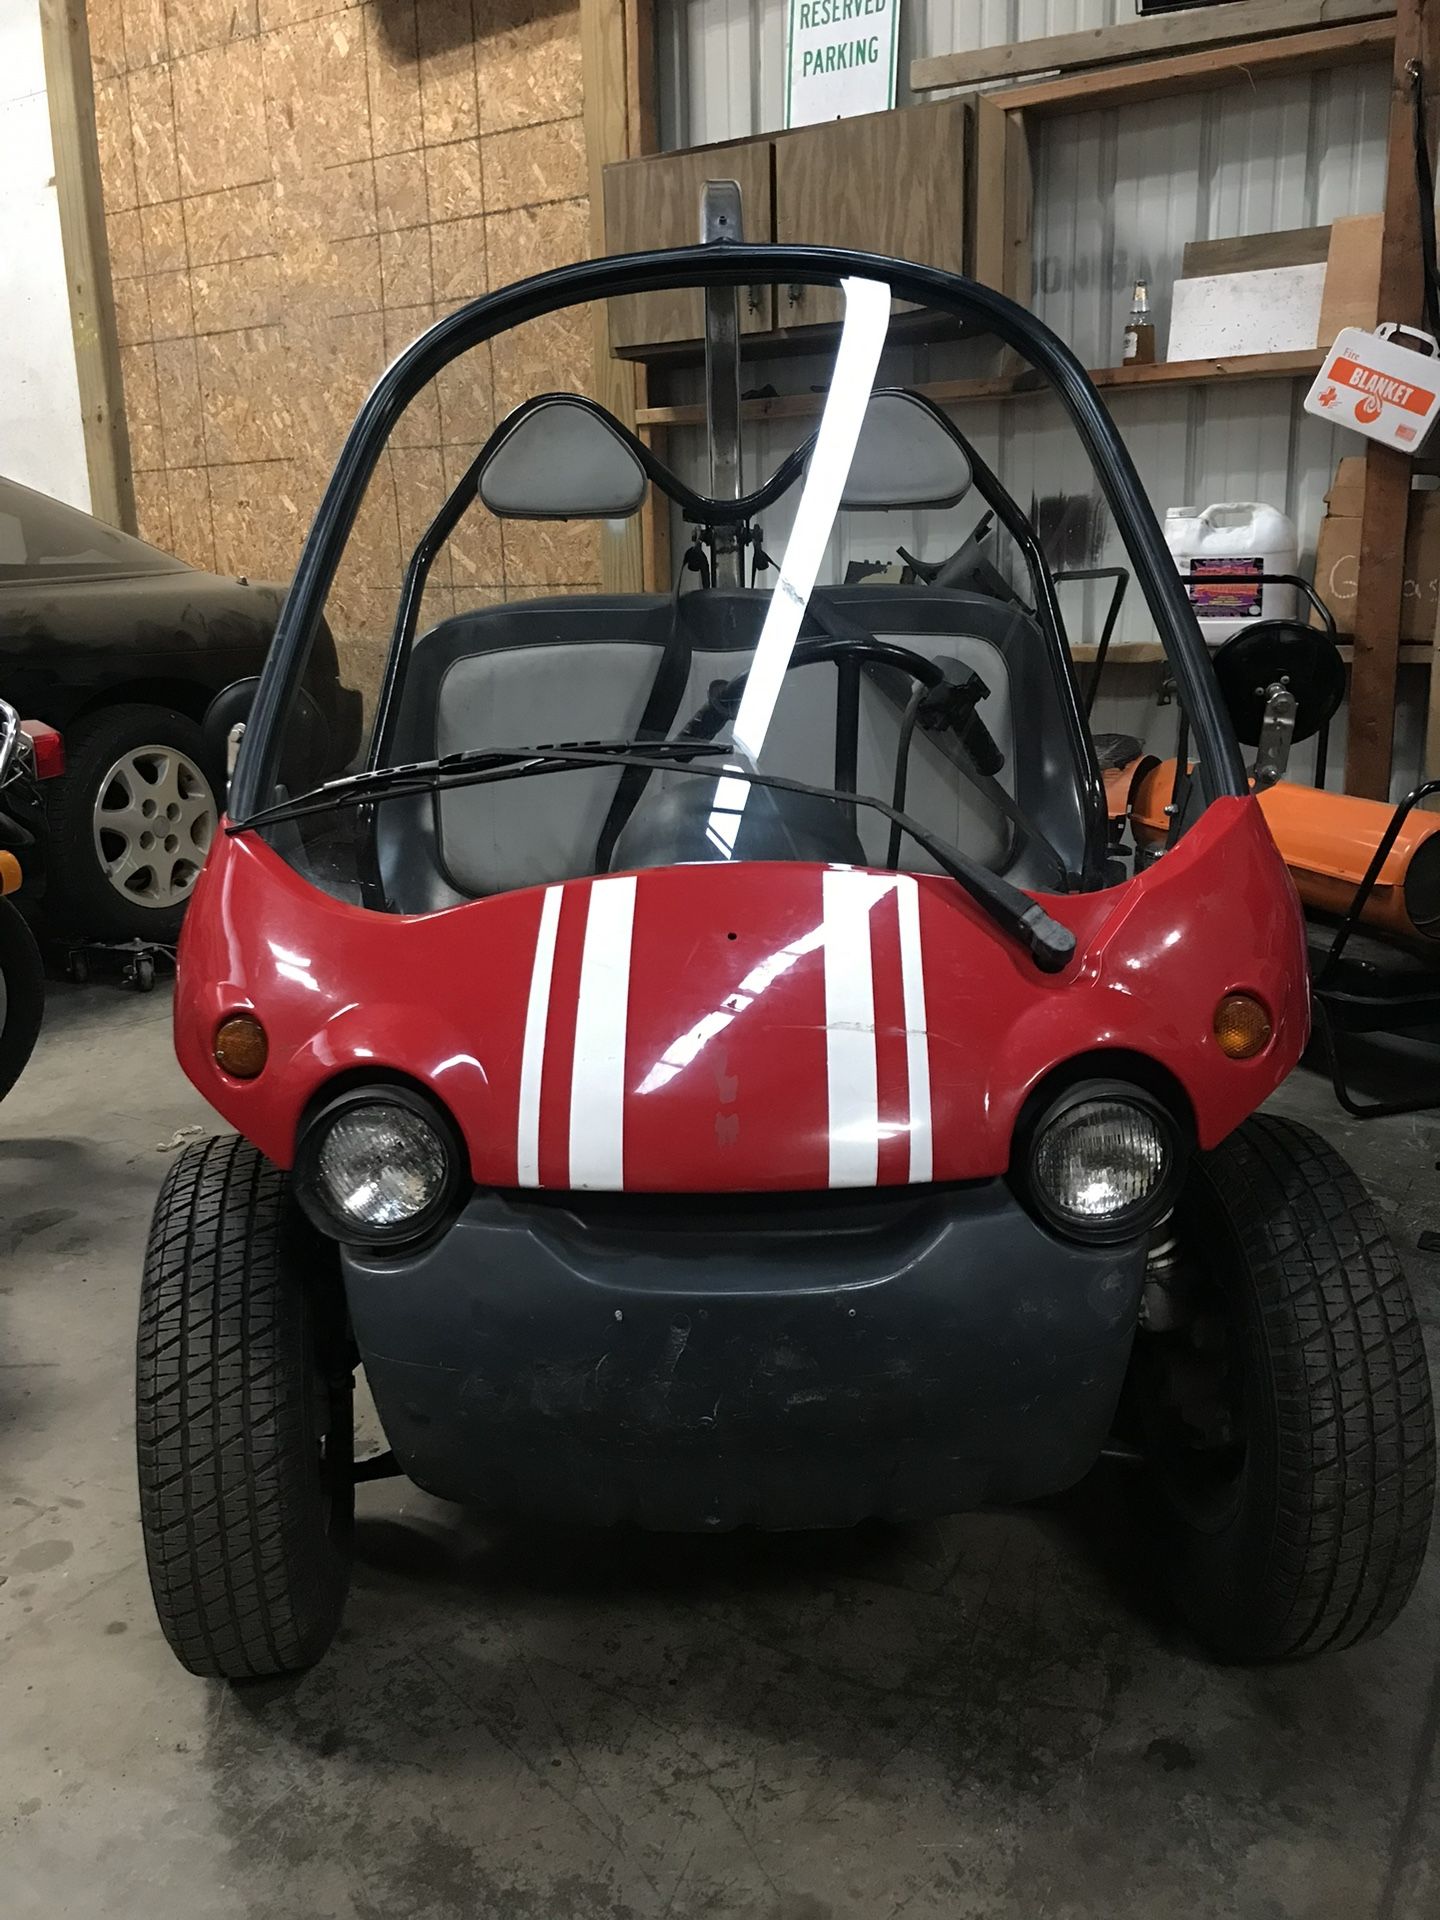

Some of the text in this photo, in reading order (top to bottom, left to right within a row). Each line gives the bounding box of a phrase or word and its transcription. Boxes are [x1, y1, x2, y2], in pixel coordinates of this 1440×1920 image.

[800, 0, 885, 30] RESERVED
[803, 36, 879, 78] PARKING
[1343, 347, 1361, 361] Fire
[1348, 367, 1415, 406] BLANKET
